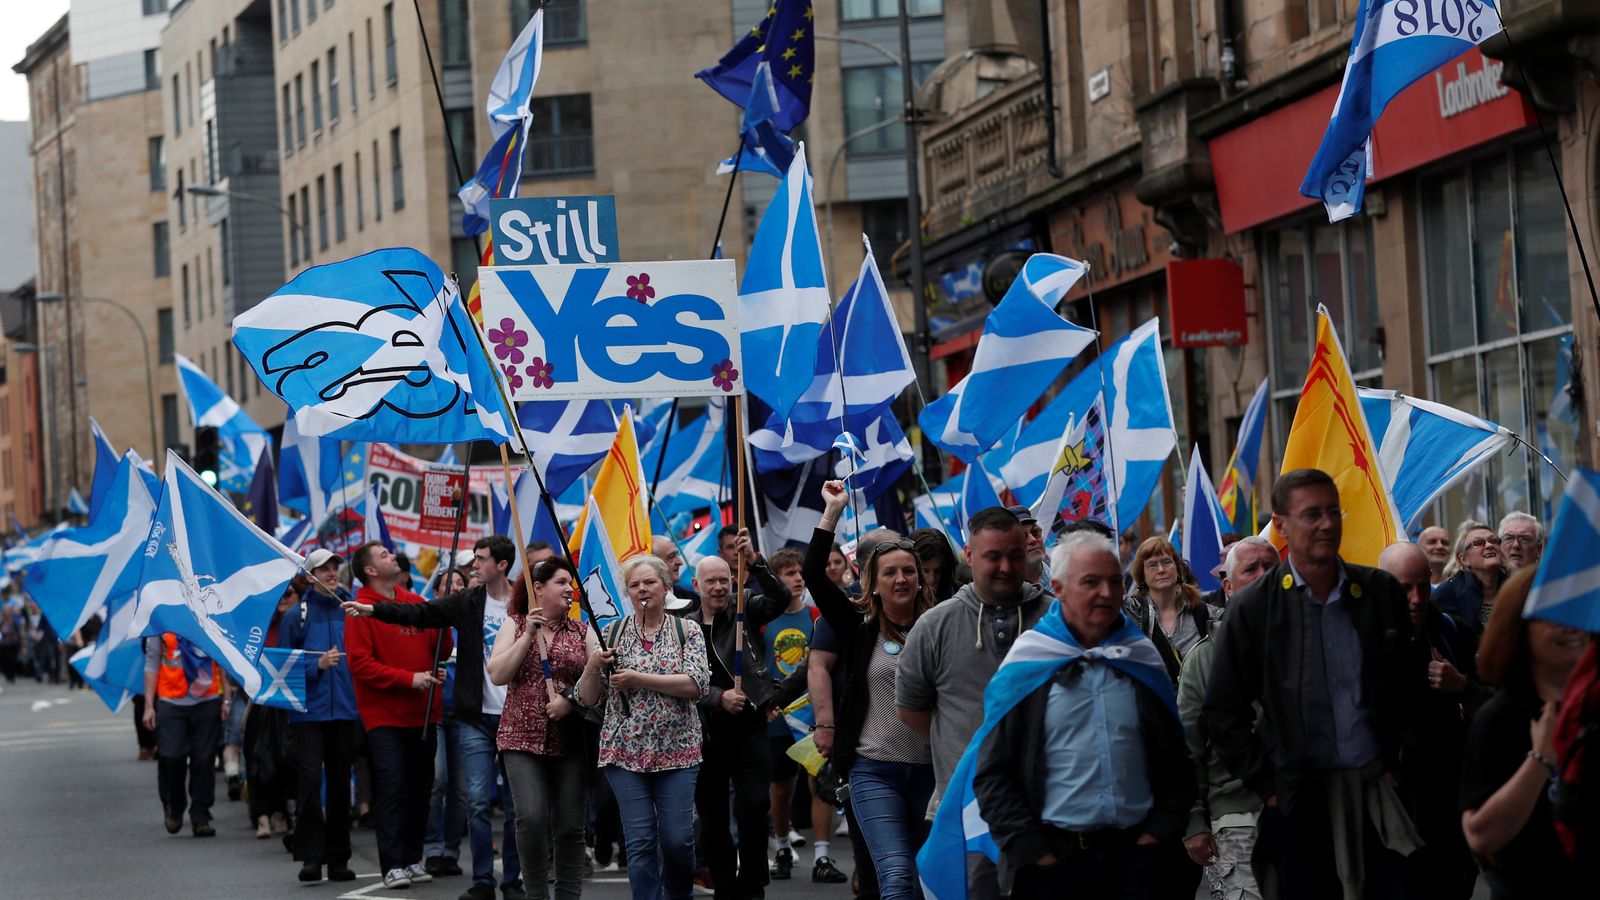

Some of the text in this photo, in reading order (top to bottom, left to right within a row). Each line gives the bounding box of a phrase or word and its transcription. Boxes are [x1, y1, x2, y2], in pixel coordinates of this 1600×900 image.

[499, 200, 607, 264] Still
[495, 268, 731, 383] Yes
[425, 473, 449, 486] DUMP
[424, 484, 454, 498] TORIES
[423, 495, 441, 506] AND
[423, 505, 458, 518] TRIDENT
